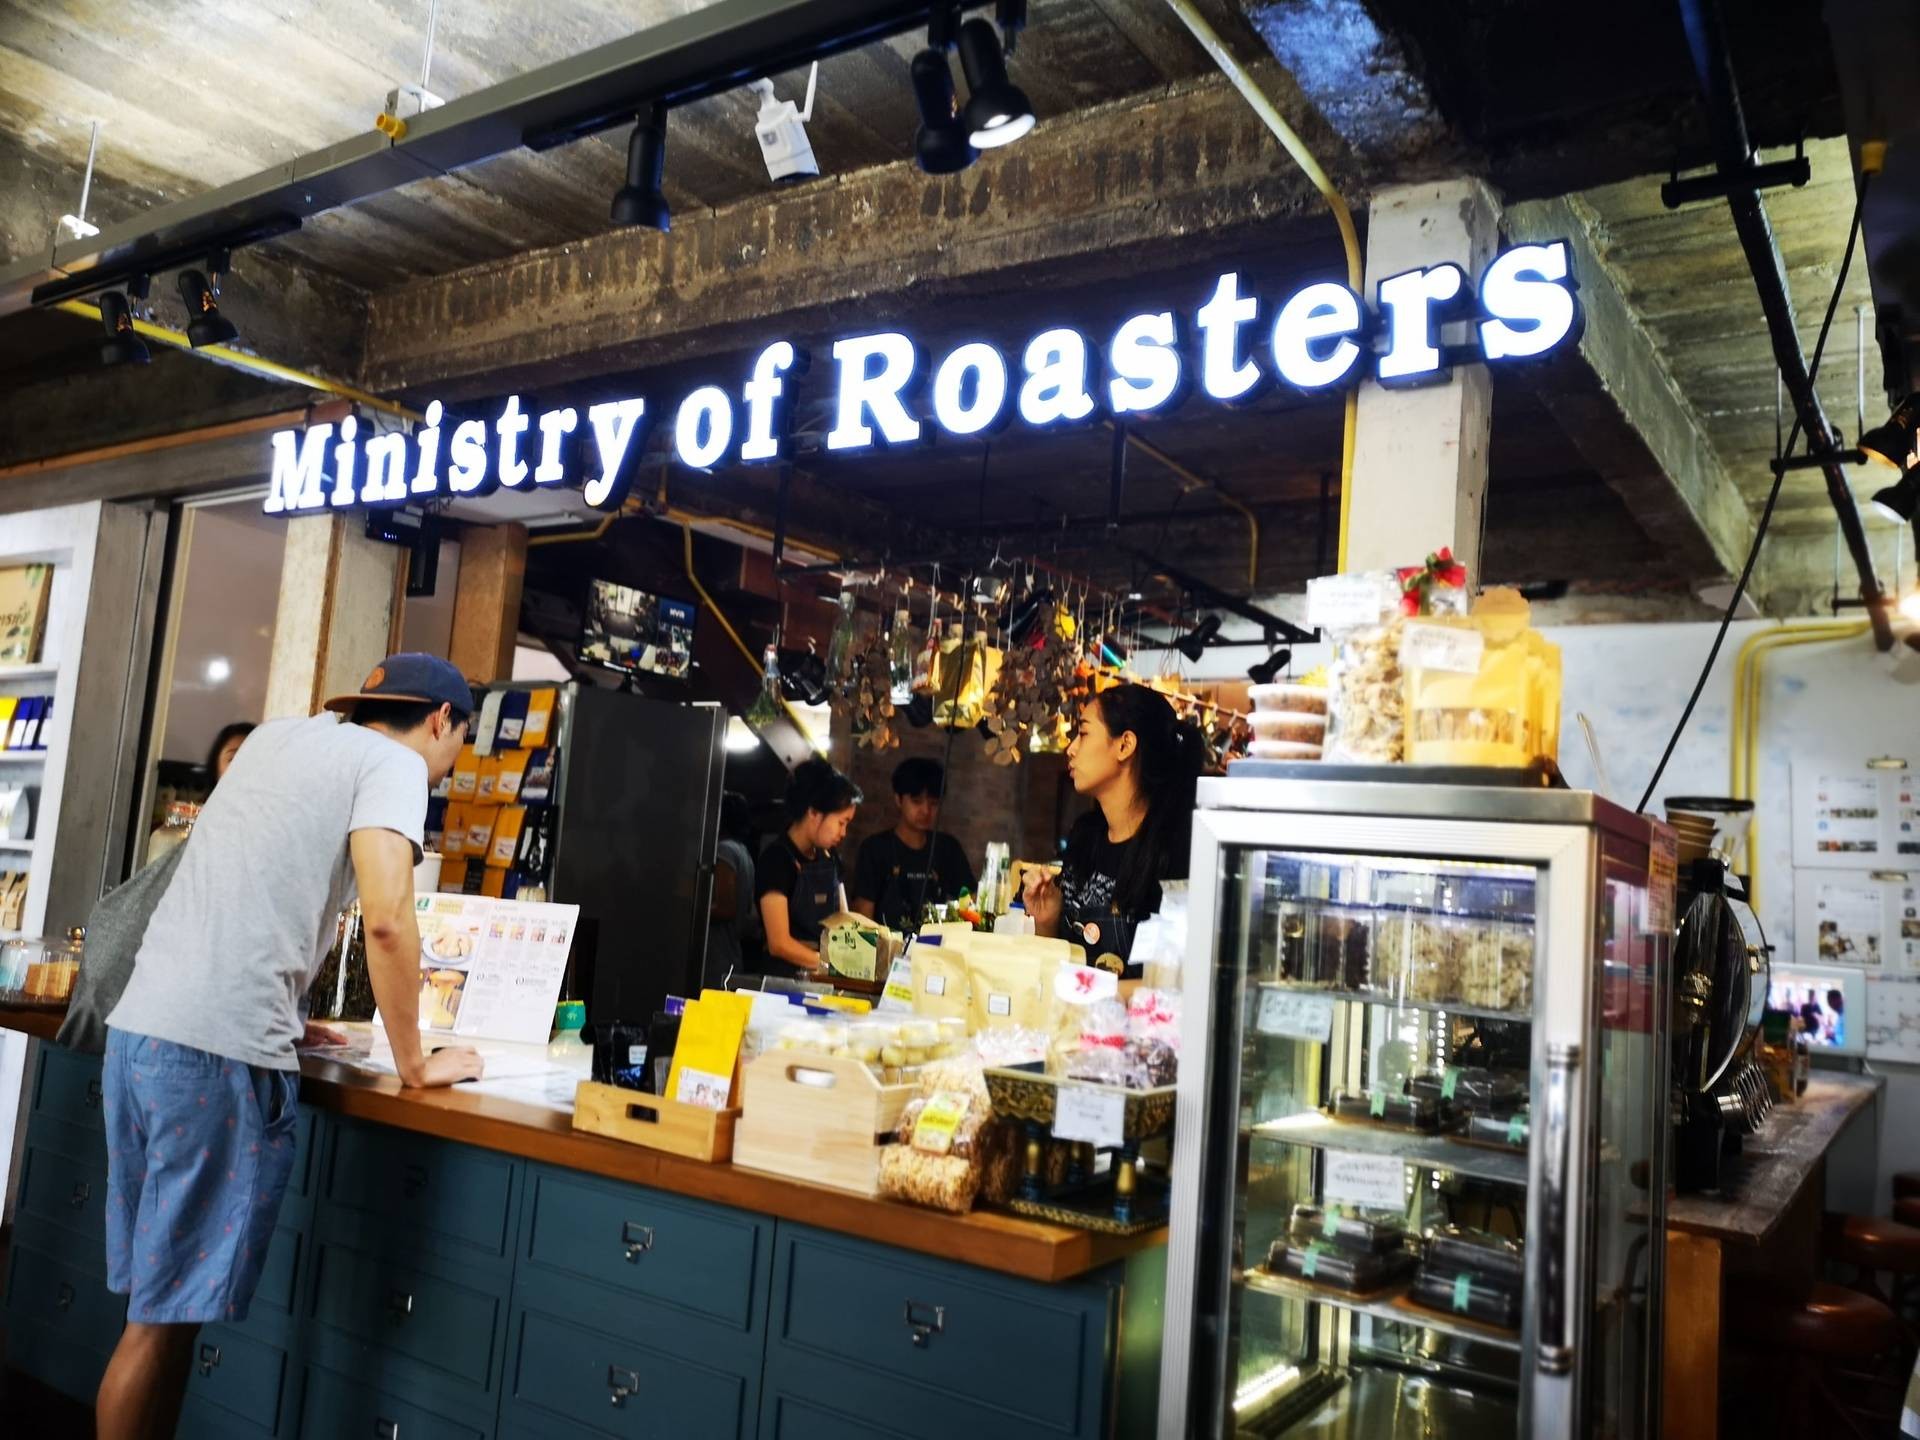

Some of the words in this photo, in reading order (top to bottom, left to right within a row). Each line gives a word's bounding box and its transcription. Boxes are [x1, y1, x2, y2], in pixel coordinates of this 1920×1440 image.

[263, 394, 645, 513] Ministry
[675, 341, 795, 468] of
[826, 241, 1575, 450] Roasters
